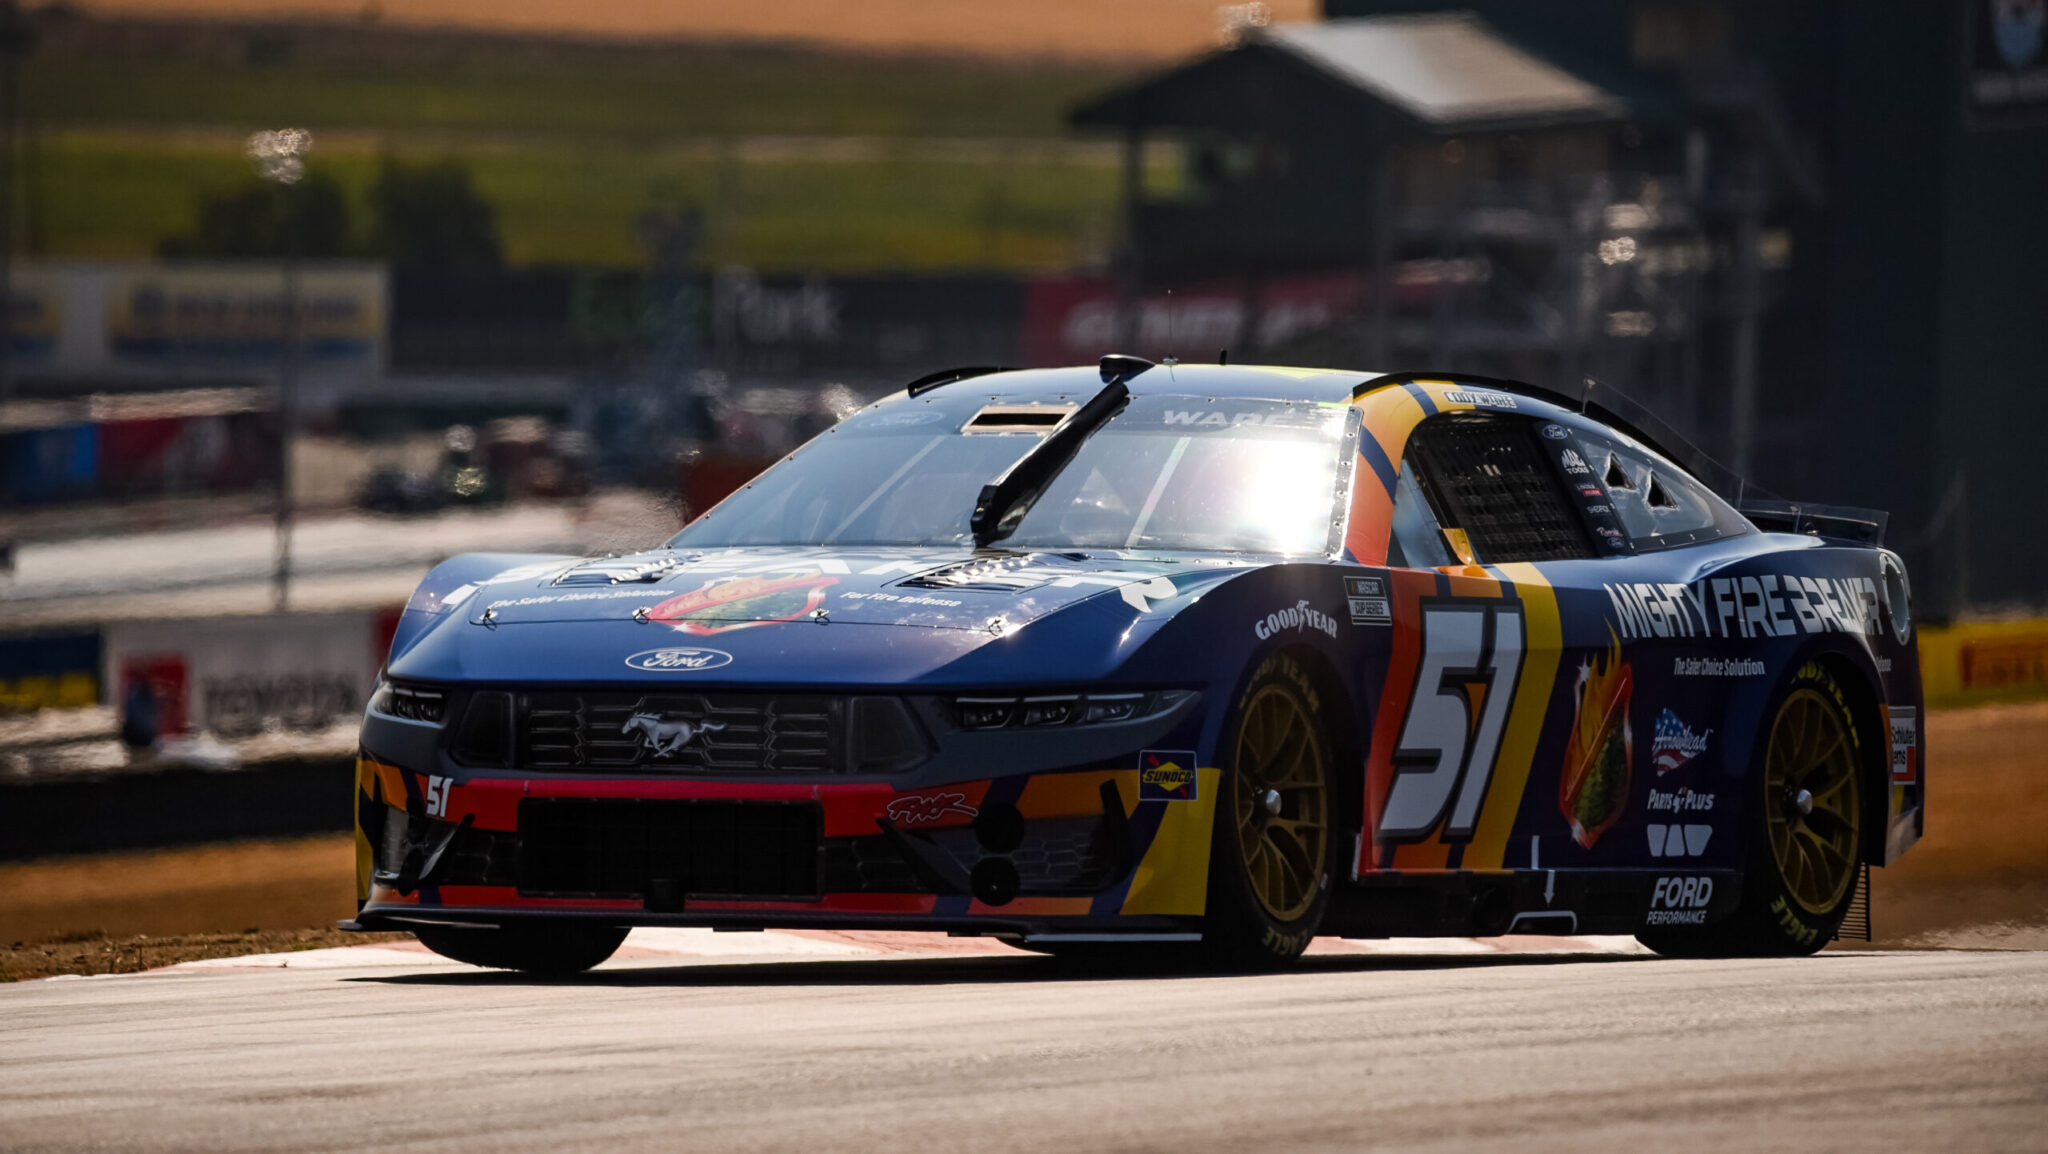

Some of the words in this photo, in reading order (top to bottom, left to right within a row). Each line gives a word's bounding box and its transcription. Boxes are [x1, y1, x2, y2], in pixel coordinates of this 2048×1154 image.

[1163, 410, 1293, 425] WARE
[1357, 580, 1380, 594] NASCAR
[867, 592, 900, 601] Fire
[897, 596, 962, 607] Defense
[1354, 602, 1365, 614] CUP
[1365, 602, 1384, 615] SERIES
[1603, 581, 1711, 638] MIGHTY
[1711, 575, 1796, 638] FIRE
[1783, 575, 1885, 635] BREAKER
[1255, 600, 1338, 640] GOODYEAR
[646, 650, 714, 669] Ford
[1674, 657, 1685, 675] The
[1701, 657, 1723, 675] Choice
[1724, 658, 1765, 676] Solution
[1379, 604, 1524, 837] 51
[1145, 769, 1194, 783] SUNOCO
[426, 776, 453, 818] 51
[1647, 788, 1673, 810] PARTS
[1685, 789, 1716, 810] PLUS
[1651, 877, 1713, 908] FORD
[1646, 910, 1707, 925] PERFORMANCE
